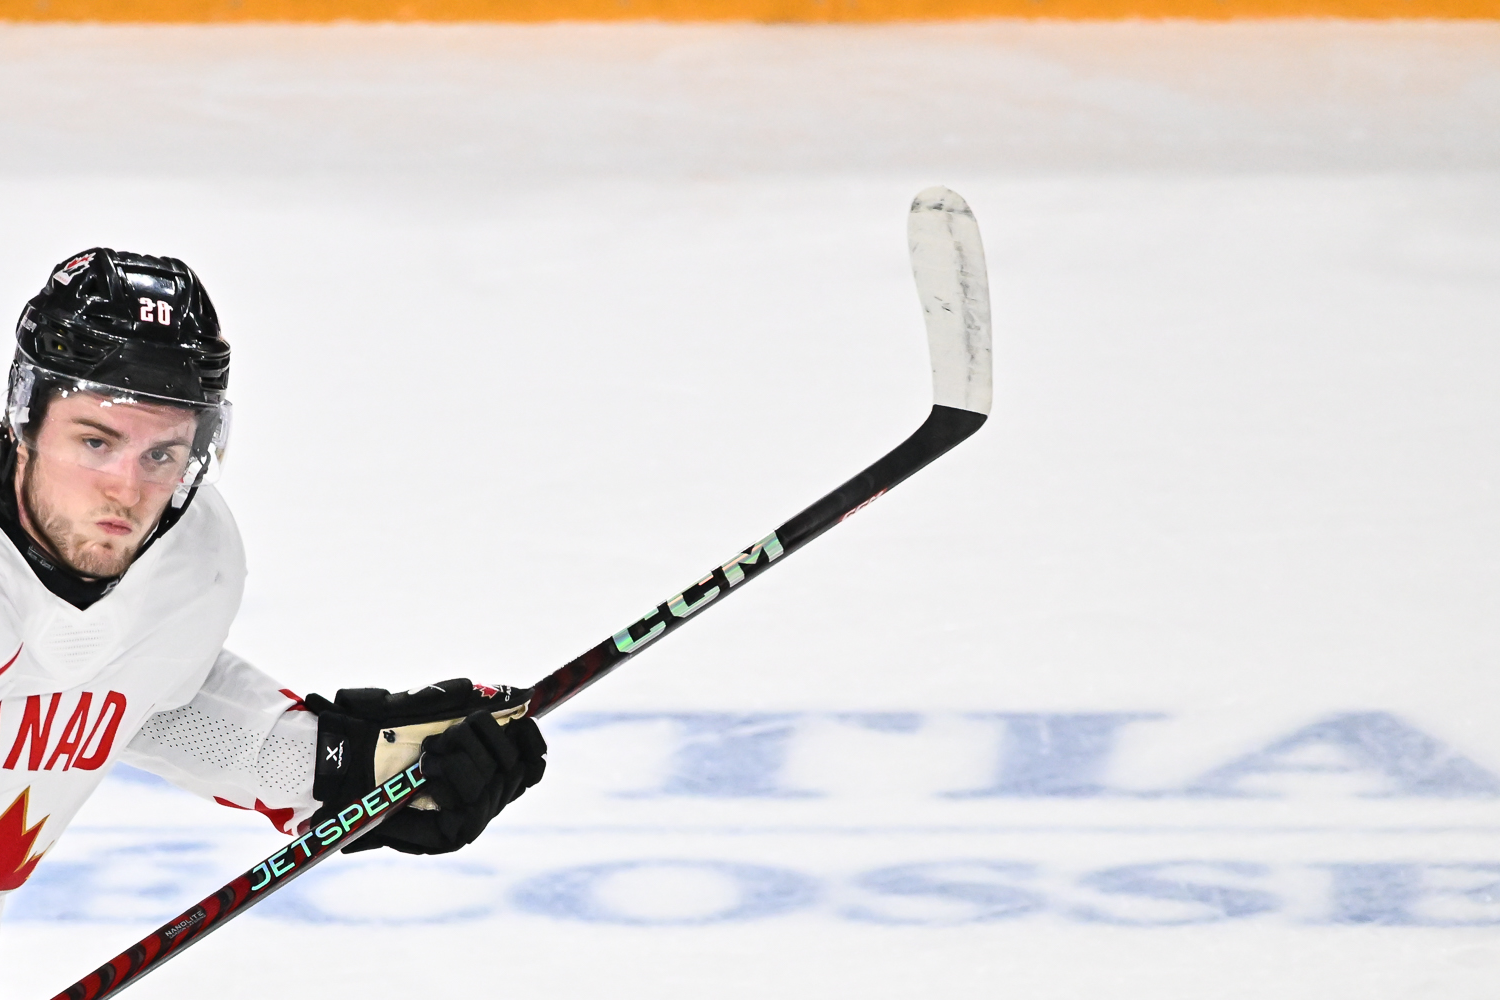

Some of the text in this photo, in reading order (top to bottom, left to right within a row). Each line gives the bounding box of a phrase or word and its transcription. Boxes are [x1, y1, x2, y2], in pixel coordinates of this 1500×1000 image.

[139, 297, 172, 326] 20
[612, 529, 784, 654] CCM
[165, 910, 204, 937] NANOLITE
